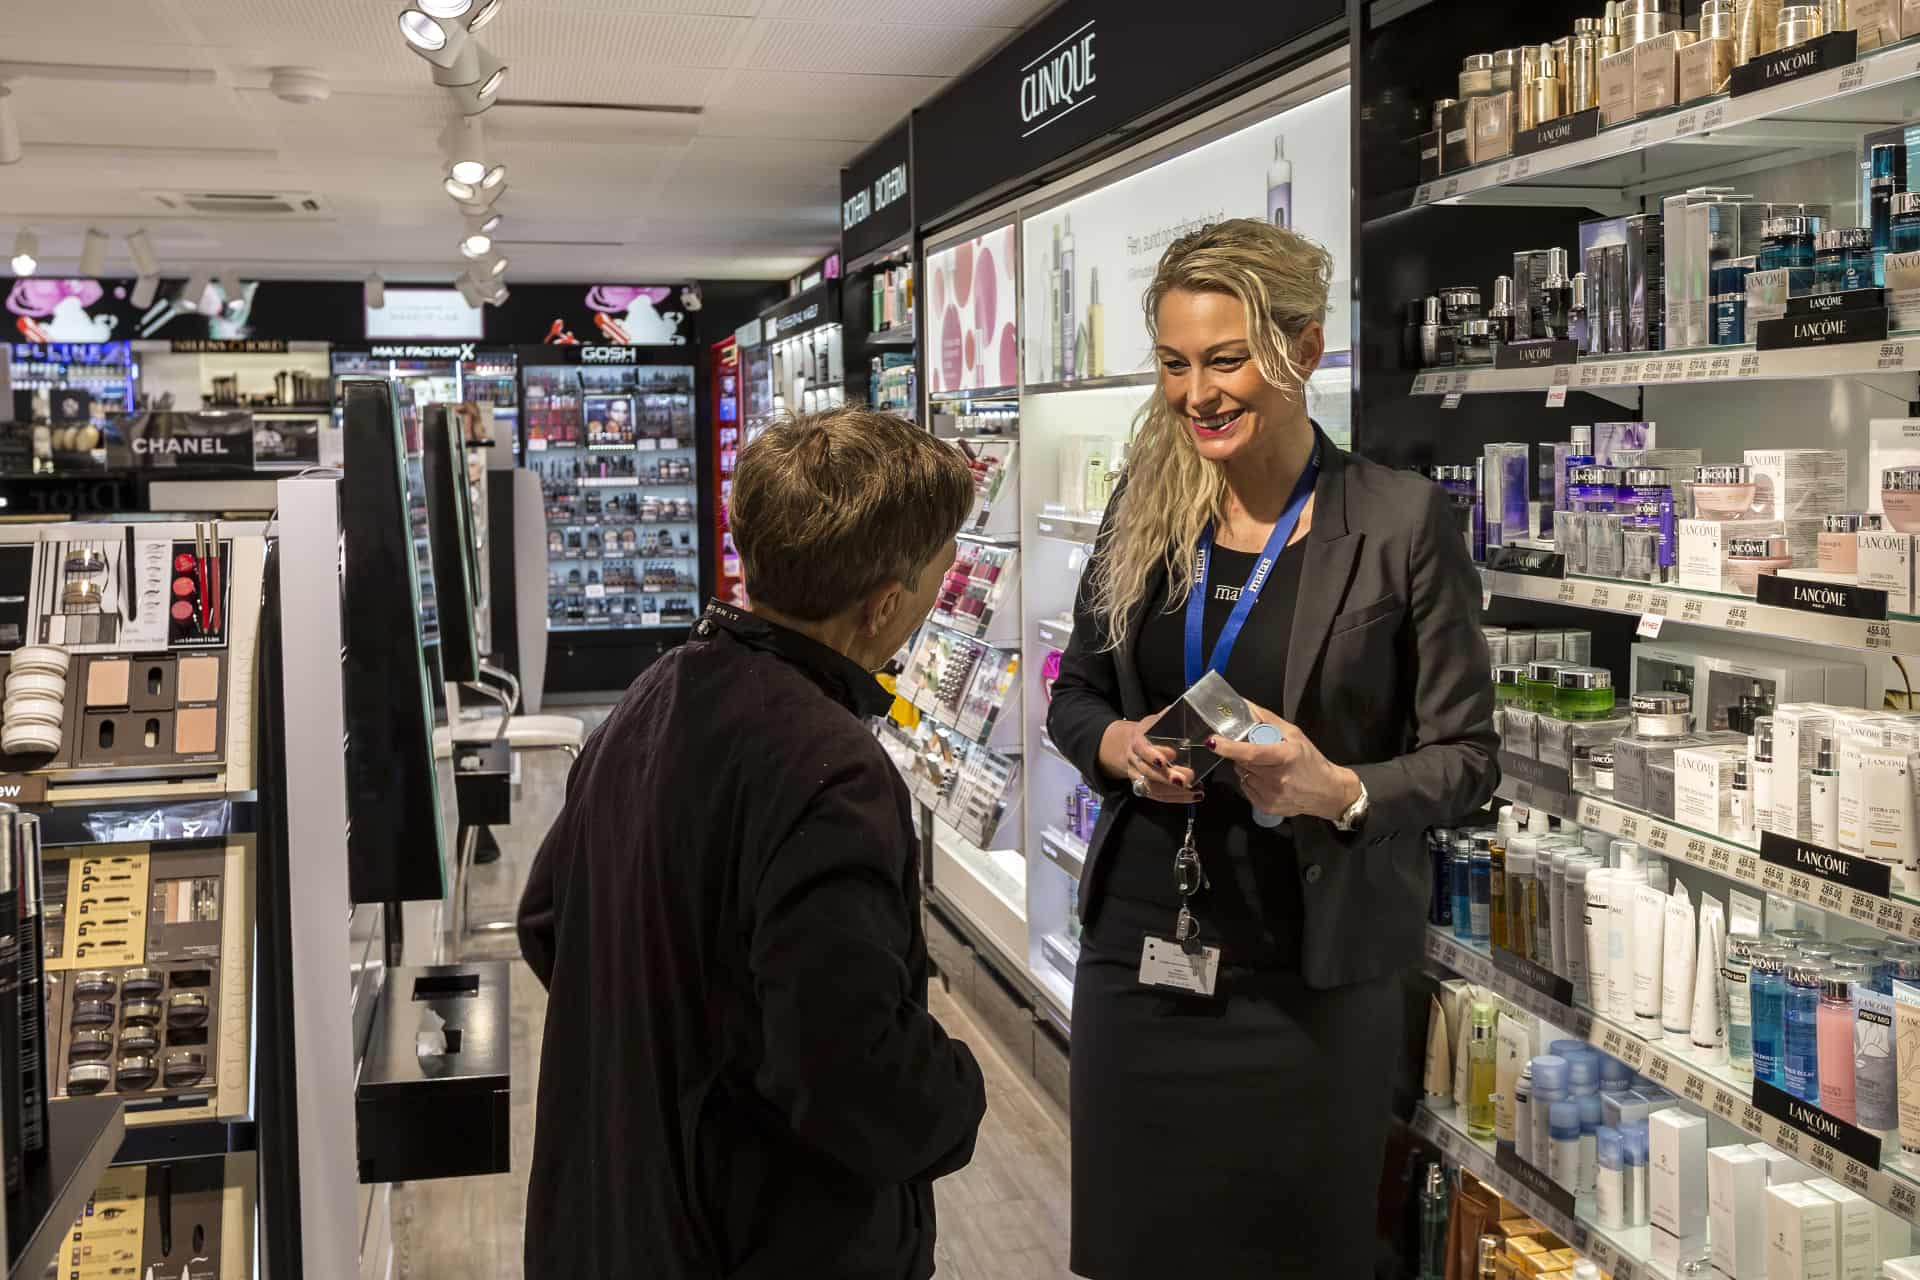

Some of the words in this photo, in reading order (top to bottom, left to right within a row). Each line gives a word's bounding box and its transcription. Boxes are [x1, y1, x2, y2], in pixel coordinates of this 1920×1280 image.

[1021, 32, 1095, 122] CLINIQUE
[1794, 319, 1847, 339] LANCÔME
[372, 346, 404, 357] MAX
[461, 344, 476, 361] X
[581, 346, 637, 361] GOSH
[132, 437, 229, 455] CHANEL
[1794, 586, 1847, 607] LANCÔME
[0, 785, 21, 798] ew
[1797, 848, 1850, 877] LANCÔME
[1789, 1102, 1841, 1140] LANCÔME
